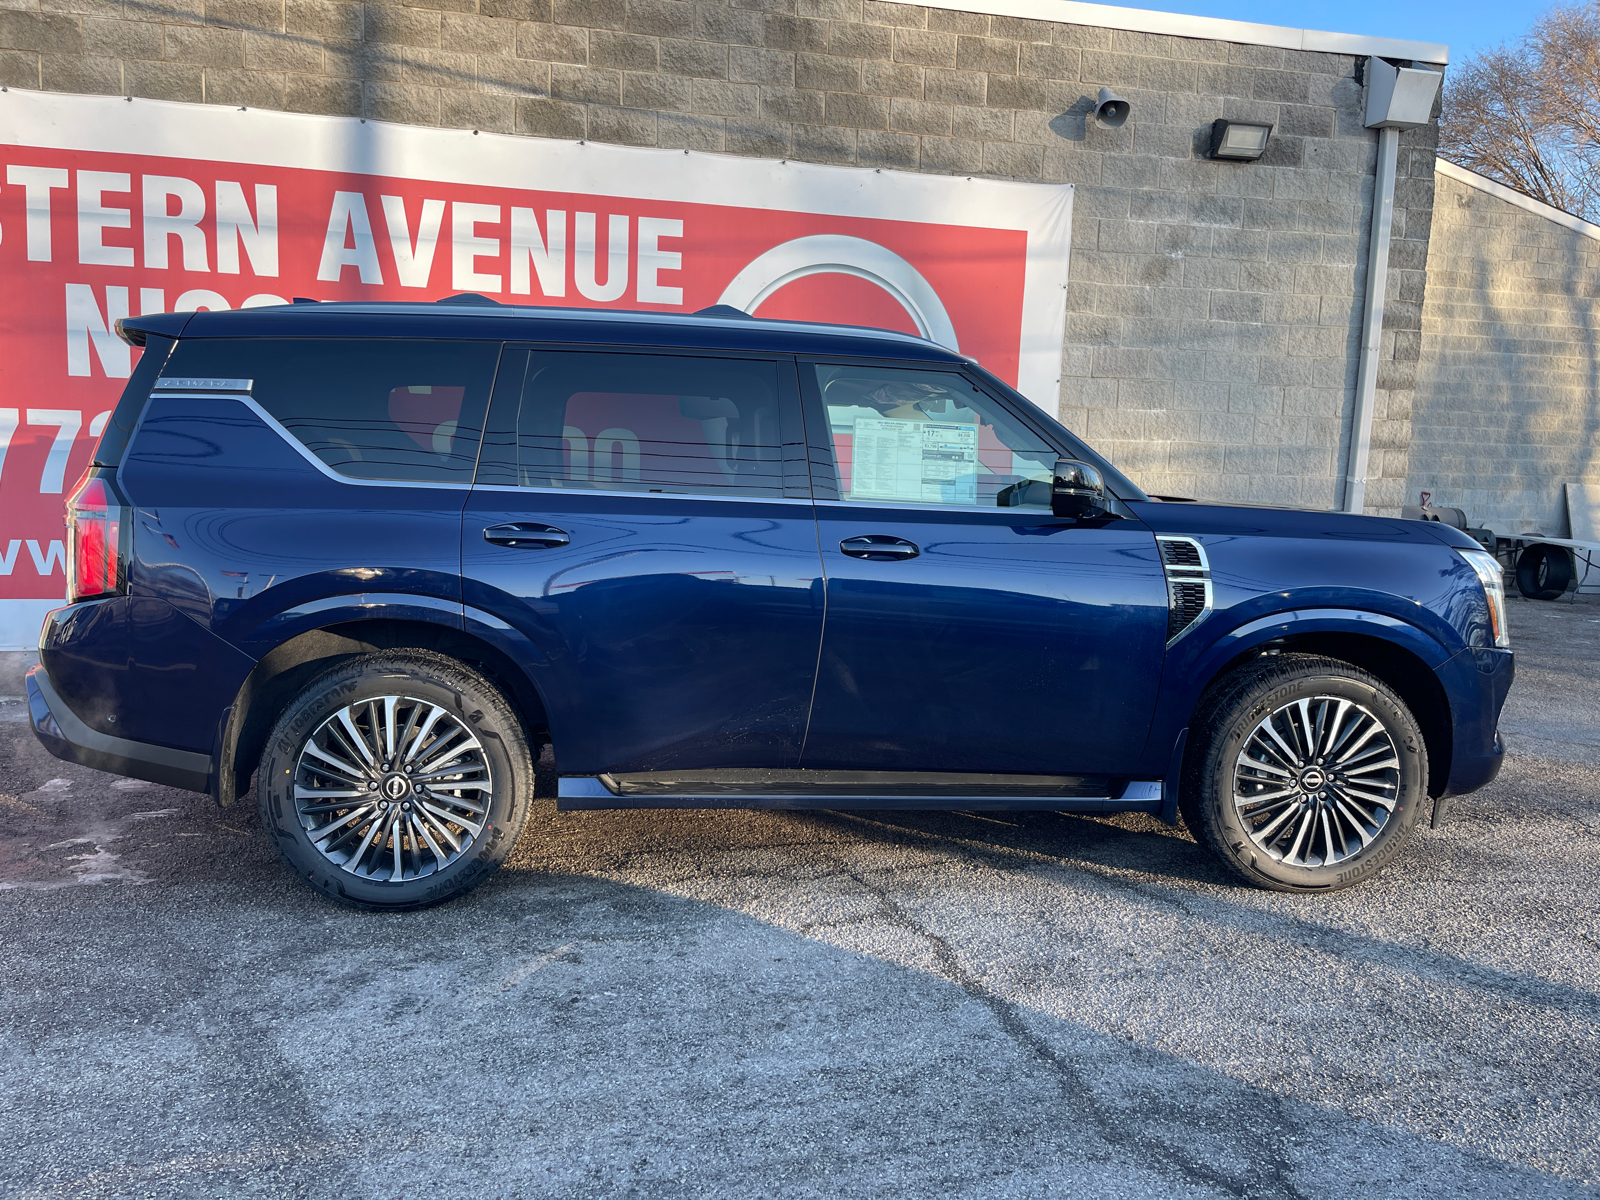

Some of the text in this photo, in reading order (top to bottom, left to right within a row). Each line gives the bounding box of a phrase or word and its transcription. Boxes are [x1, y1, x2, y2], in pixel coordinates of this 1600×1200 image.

[0, 164, 684, 305] TERN AVENUE
[164, 379, 232, 388] ARMADA
[1335, 821, 1409, 883] BRIDGESTONE
